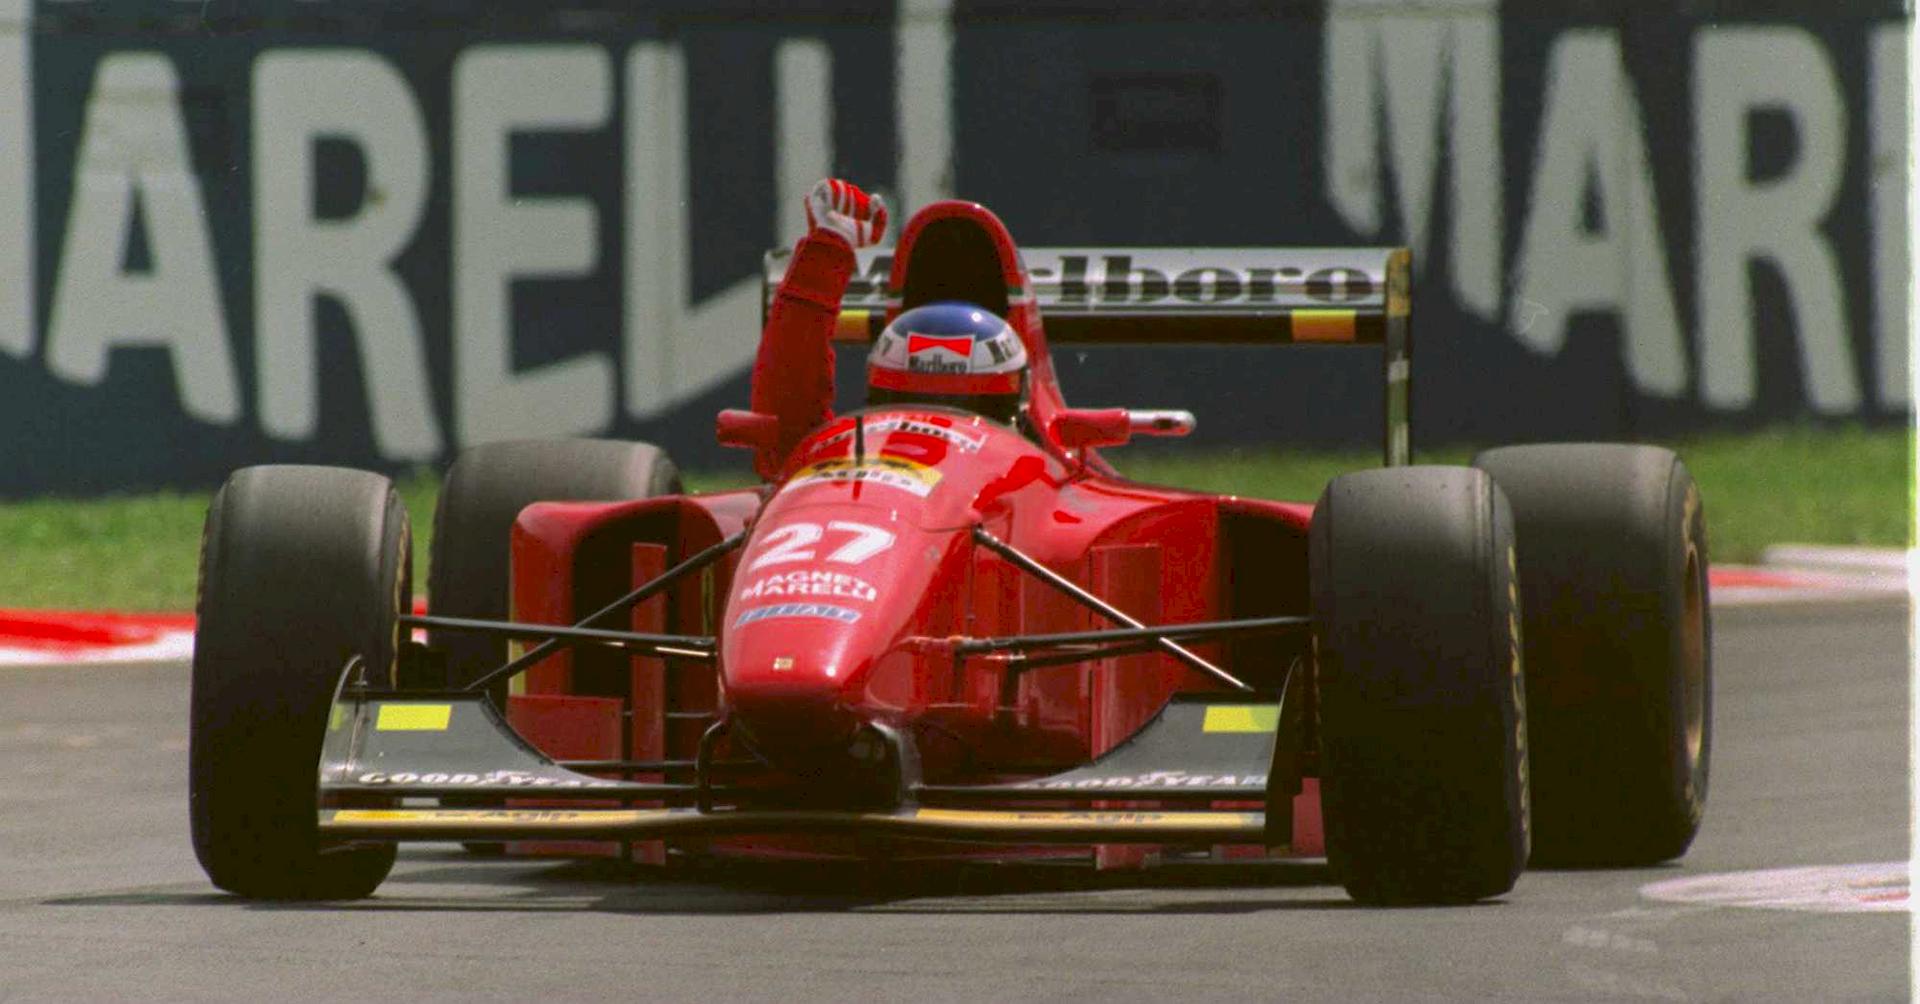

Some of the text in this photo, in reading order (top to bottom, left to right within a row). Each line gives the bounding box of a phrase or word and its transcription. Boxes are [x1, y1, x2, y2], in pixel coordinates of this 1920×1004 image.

[0, 0, 953, 463] ARELLI
[842, 254, 1375, 302] Mlboro
[749, 519, 896, 573] 27
